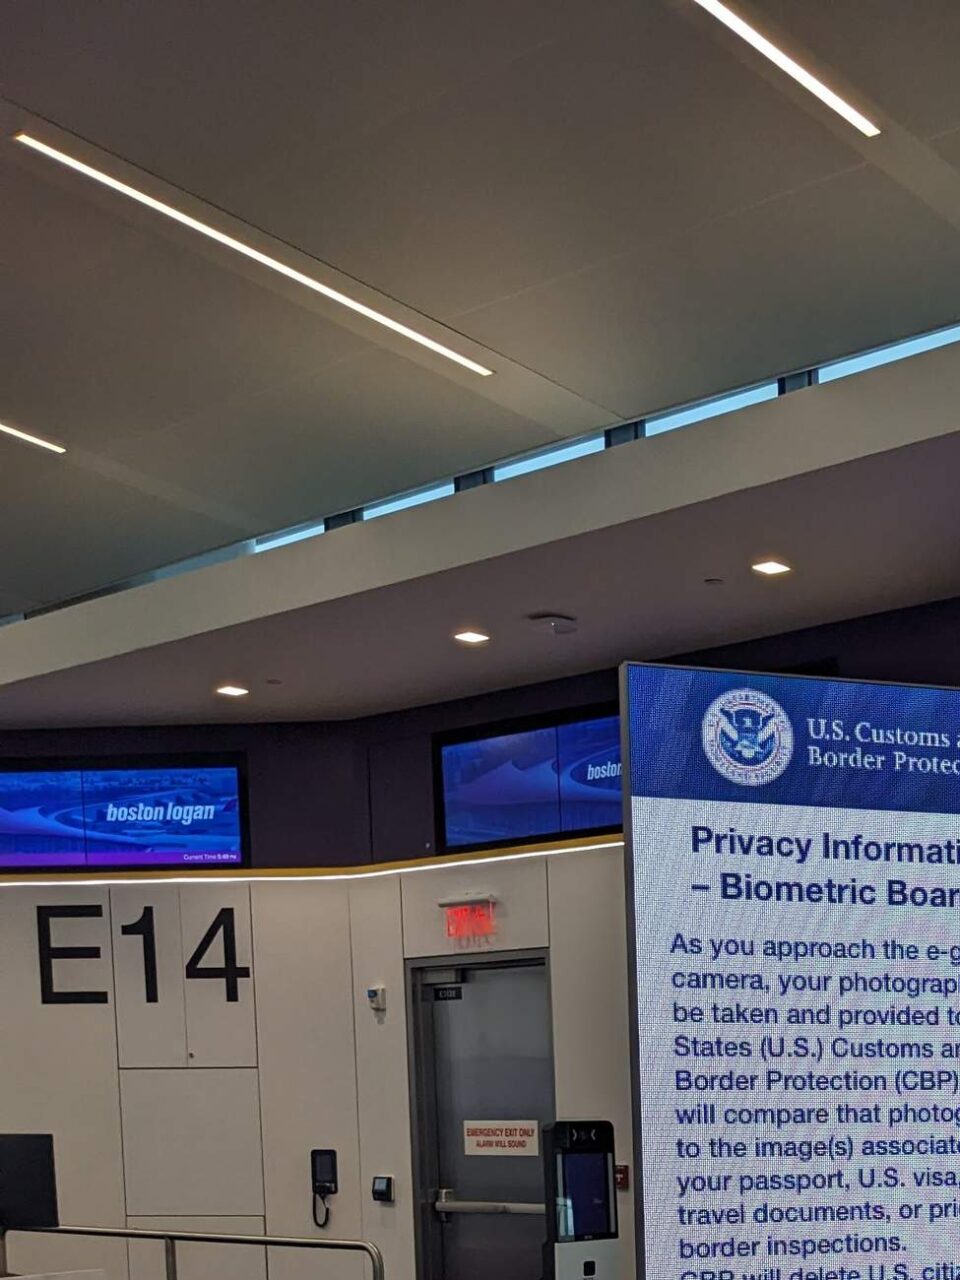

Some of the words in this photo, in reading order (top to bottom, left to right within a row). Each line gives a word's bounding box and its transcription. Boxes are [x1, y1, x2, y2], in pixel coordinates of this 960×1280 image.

[807, 717, 849, 740] U.S.
[854, 721, 950, 747] Customs
[807, 744, 885, 769] Border
[106, 803, 164, 821] boston
[166, 802, 215, 825] logan
[690, 824, 812, 864] Privacy
[719, 871, 875, 905] Biometric
[36, 904, 251, 1004] E14
[671, 971, 769, 992] camera,
[778, 974, 831, 996] your
[673, 1034, 752, 1057] States
[759, 1035, 823, 1061] (U.S.)
[831, 1036, 933, 1058] Customs
[674, 1069, 758, 1091] Border
[765, 1068, 887, 1091] Protection
[674, 1103, 715, 1124] will
[723, 1107, 828, 1128] compare
[835, 1103, 880, 1123] that
[466, 1127, 503, 1137] EMERGENCY
[504, 1127, 517, 1137] EXIT
[519, 1127, 535, 1137] ONLY
[476, 1140, 494, 1148] ALARM
[495, 1140, 507, 1148] WILL
[508, 1140, 527, 1148] SOUND
[676, 1174, 732, 1198] your
[738, 1169, 850, 1195] passport,
[857, 1166, 904, 1188] U.S.
[677, 1203, 745, 1225] travel
[752, 1201, 891, 1224] documents,
[898, 1203, 922, 1219] or
